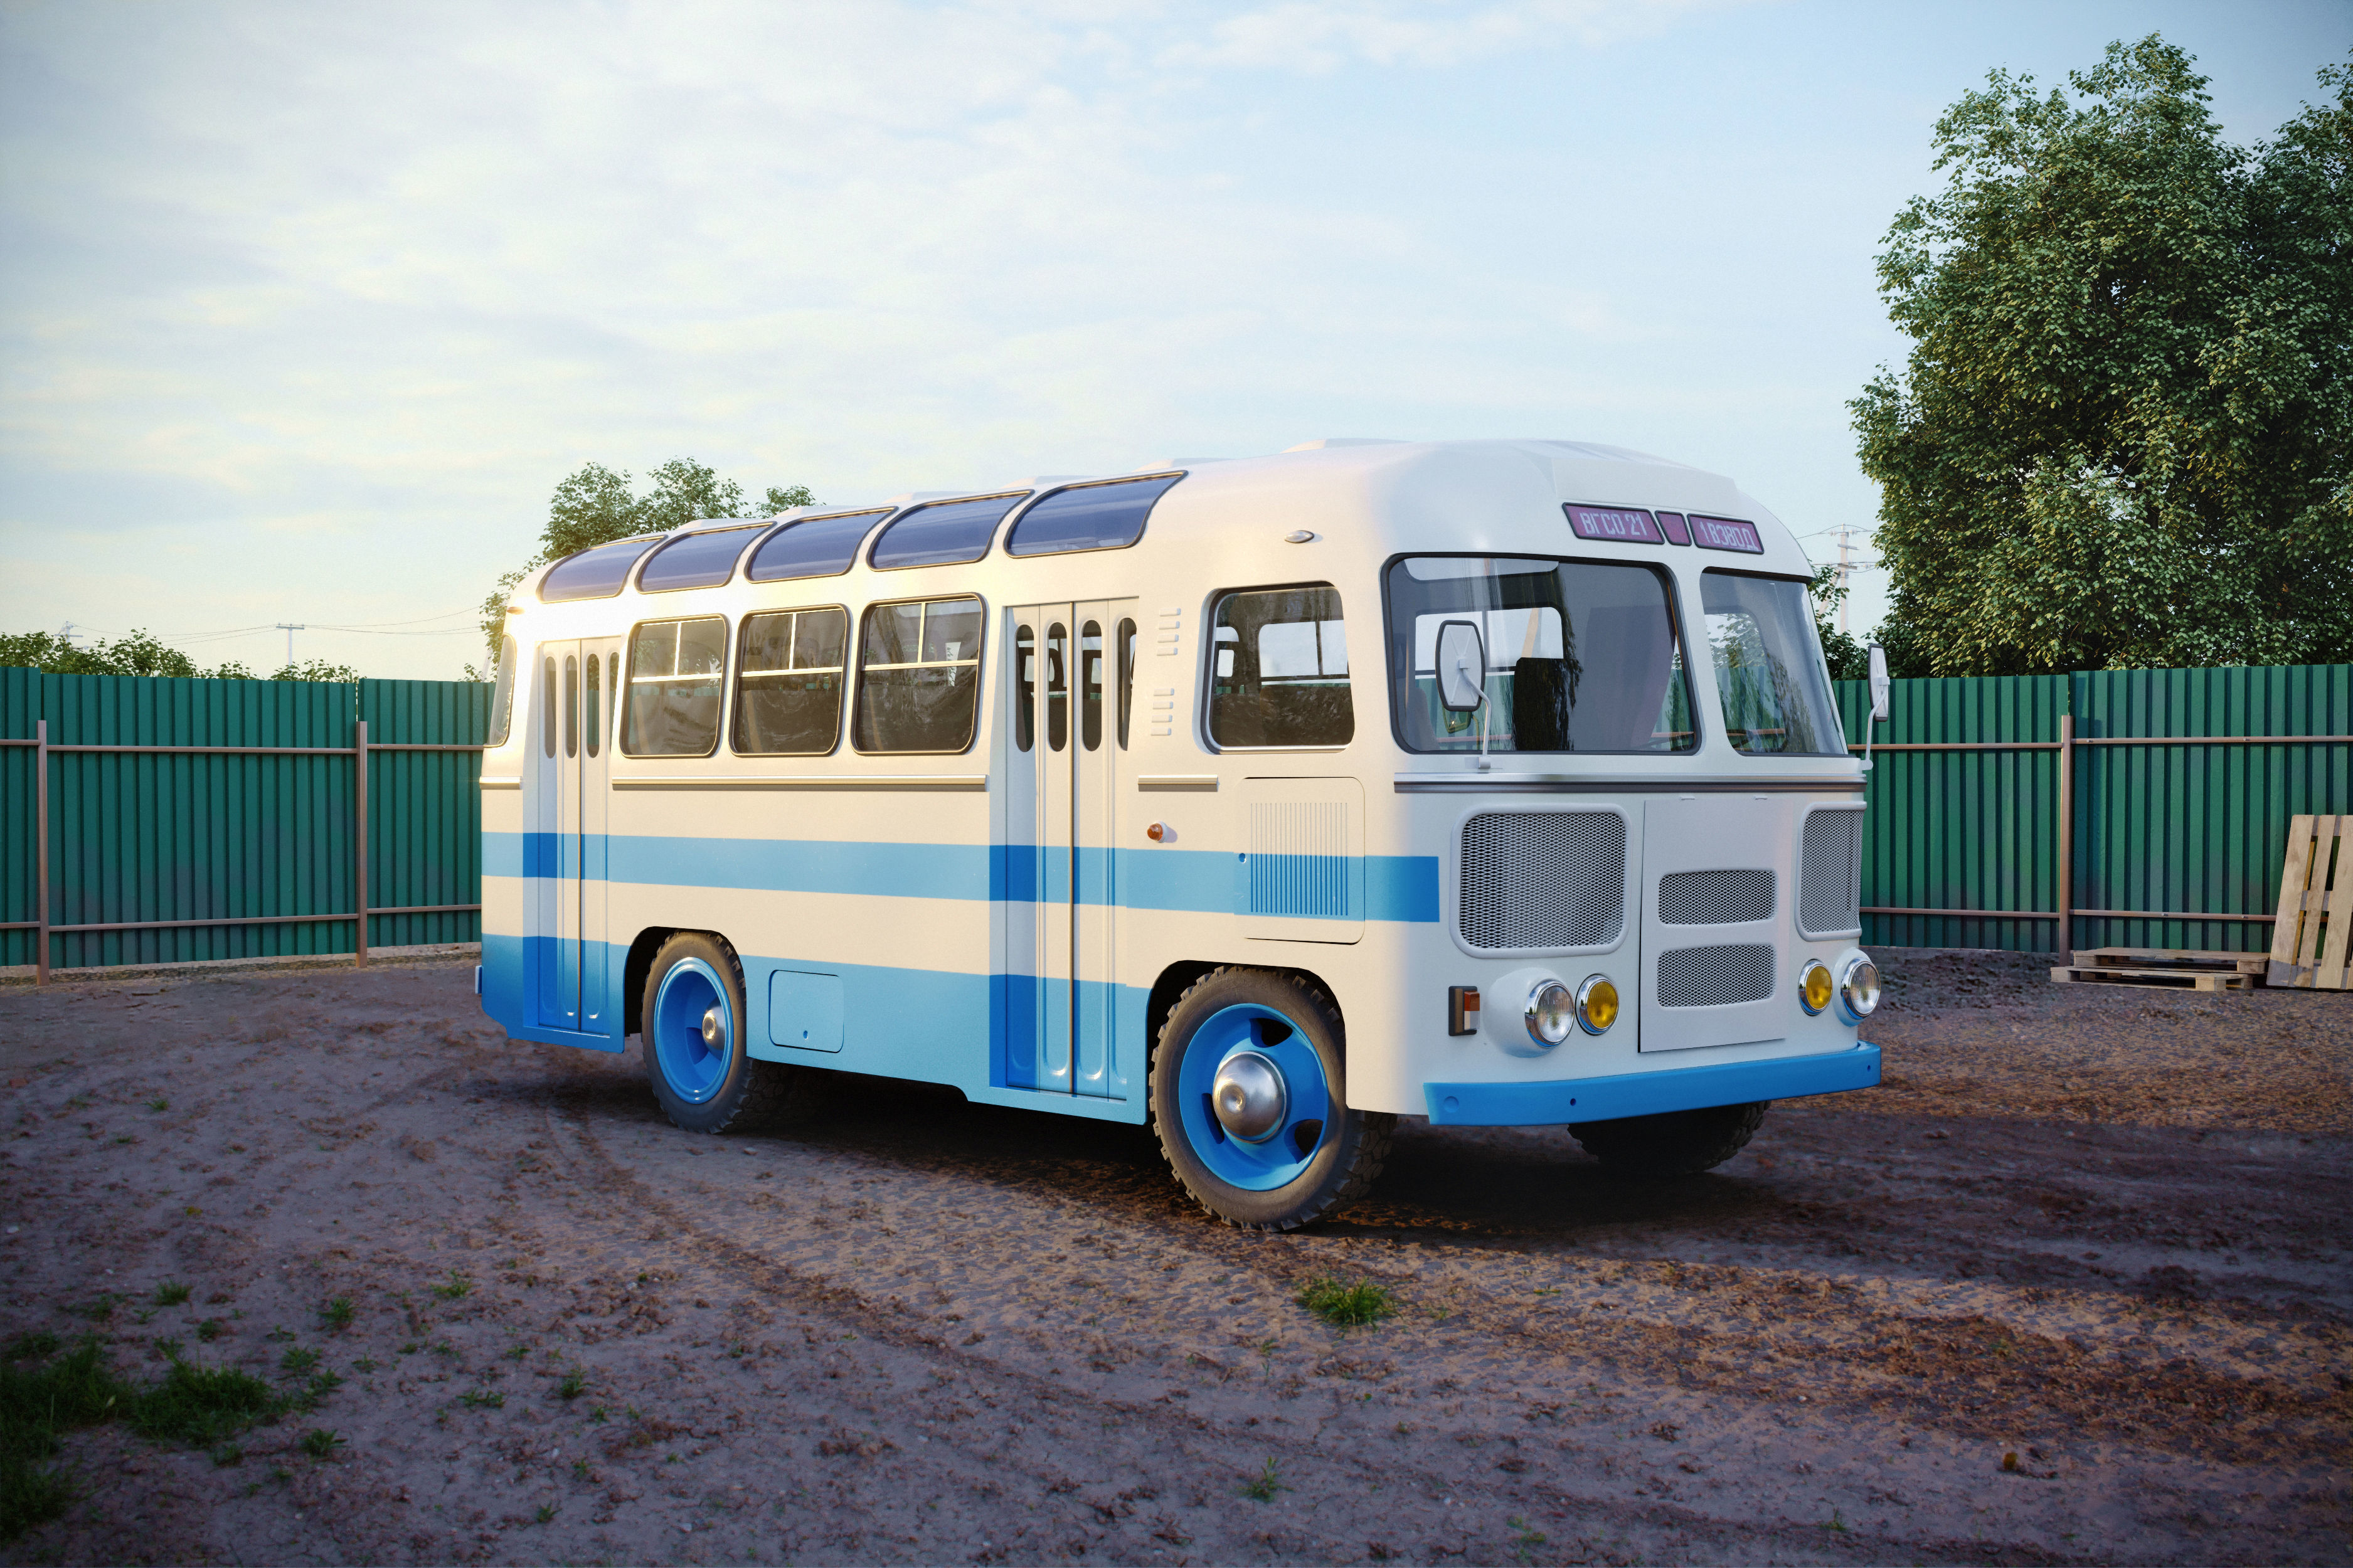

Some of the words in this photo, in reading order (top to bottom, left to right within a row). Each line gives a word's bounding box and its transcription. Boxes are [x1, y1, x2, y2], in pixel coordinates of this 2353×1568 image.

[1580, 512, 1626, 535] ВГСО
[1625, 512, 1647, 536] 21
[1699, 521, 1711, 544] 1
[1706, 522, 1758, 551] ВЗВОД
